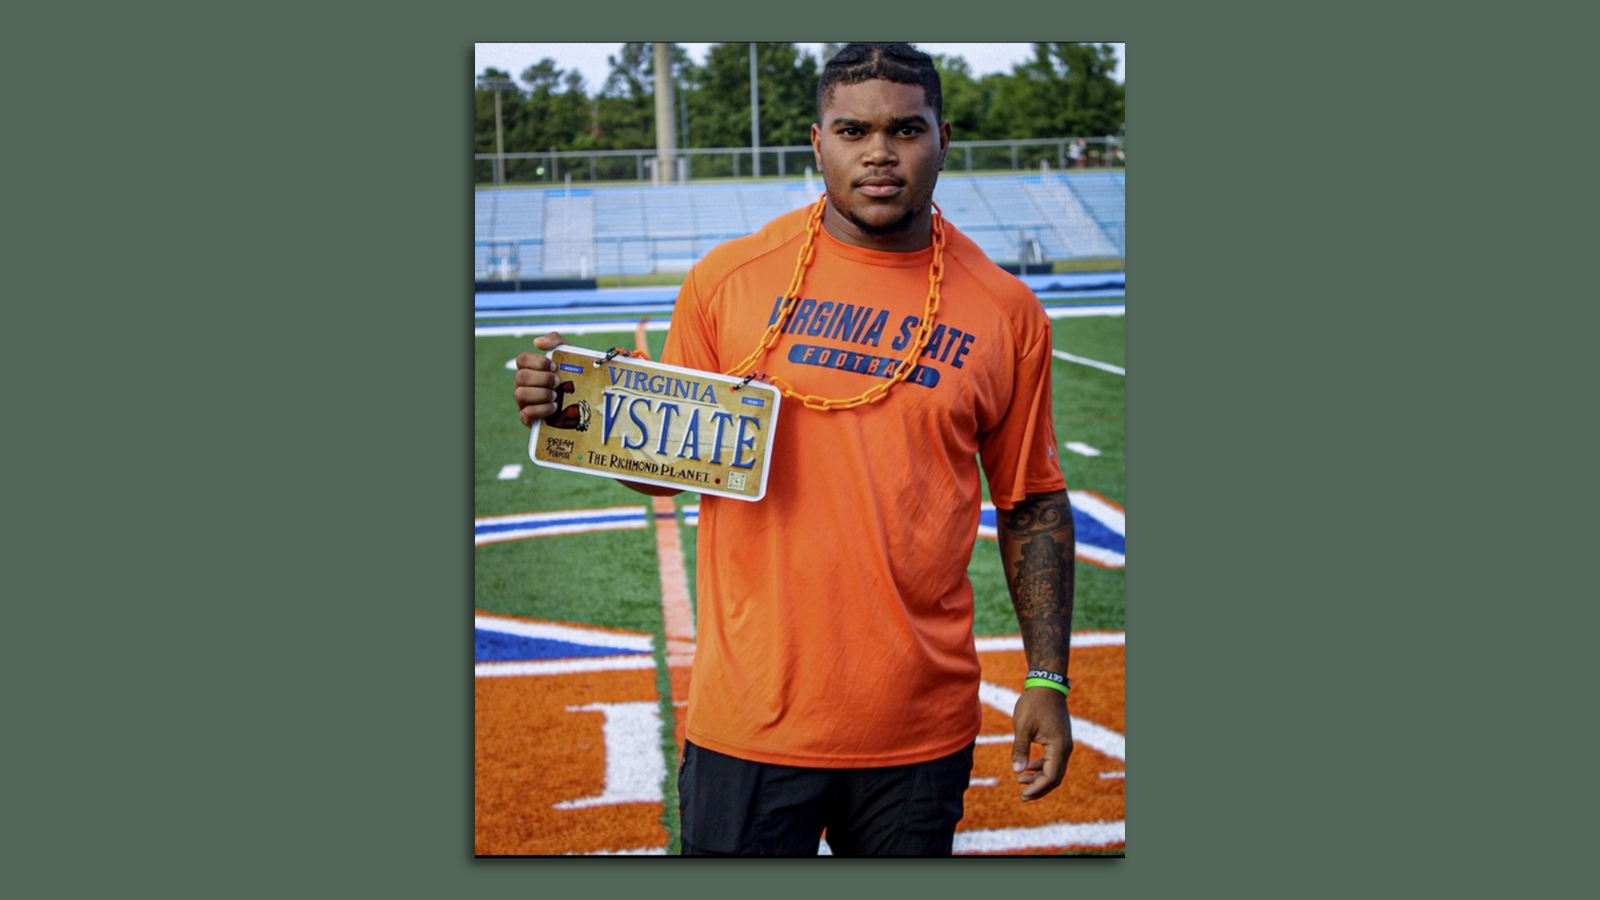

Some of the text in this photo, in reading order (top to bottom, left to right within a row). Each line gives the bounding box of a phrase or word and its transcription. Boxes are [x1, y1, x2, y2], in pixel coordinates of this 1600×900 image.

[768, 297, 890, 347] VIRGINIA
[608, 366, 718, 404] VIRGINIA
[602, 391, 761, 469] VSTATE
[588, 450, 607, 466] THE
[1048, 672, 1064, 682] GET
